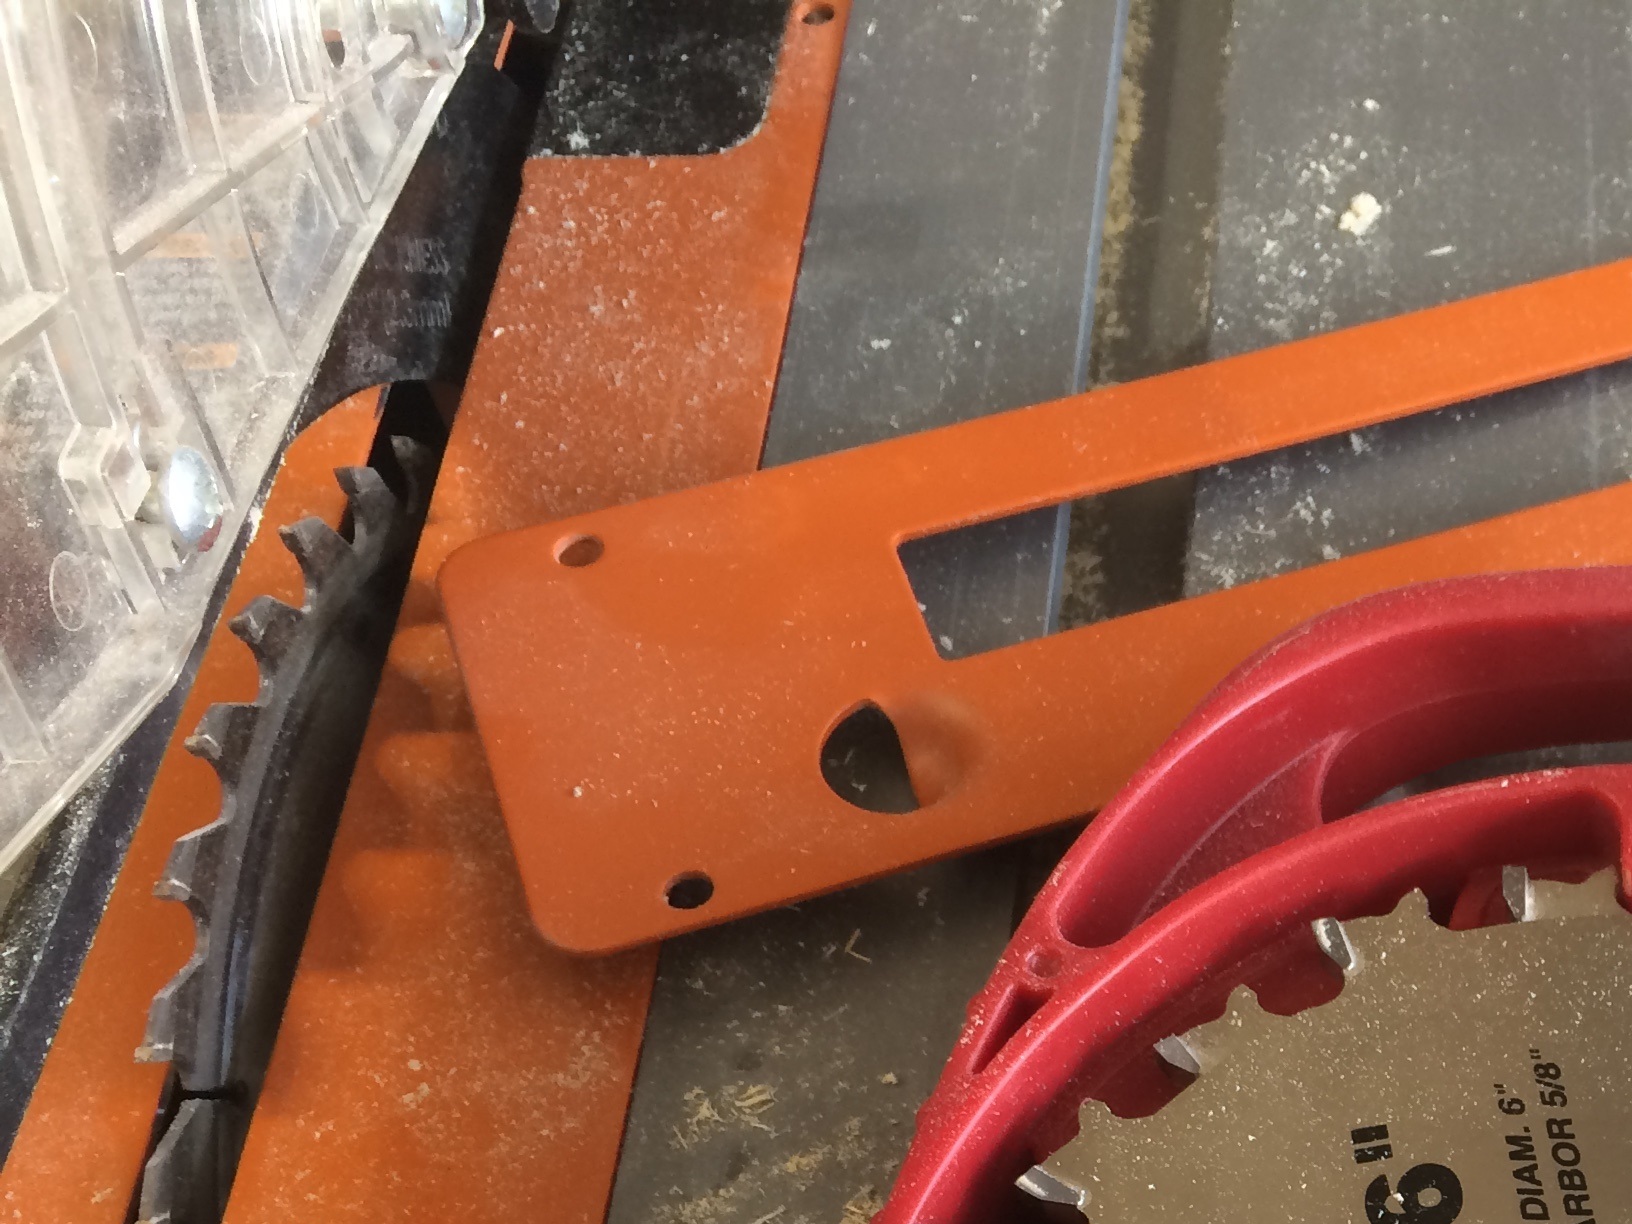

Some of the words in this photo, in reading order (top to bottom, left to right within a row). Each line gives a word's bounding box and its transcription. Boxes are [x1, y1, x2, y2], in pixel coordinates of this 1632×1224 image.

[1493, 1083, 1526, 1116] 6"
[1529, 1048, 1568, 1108] 5/8"
[1504, 1126, 1550, 1221] DIAM.
